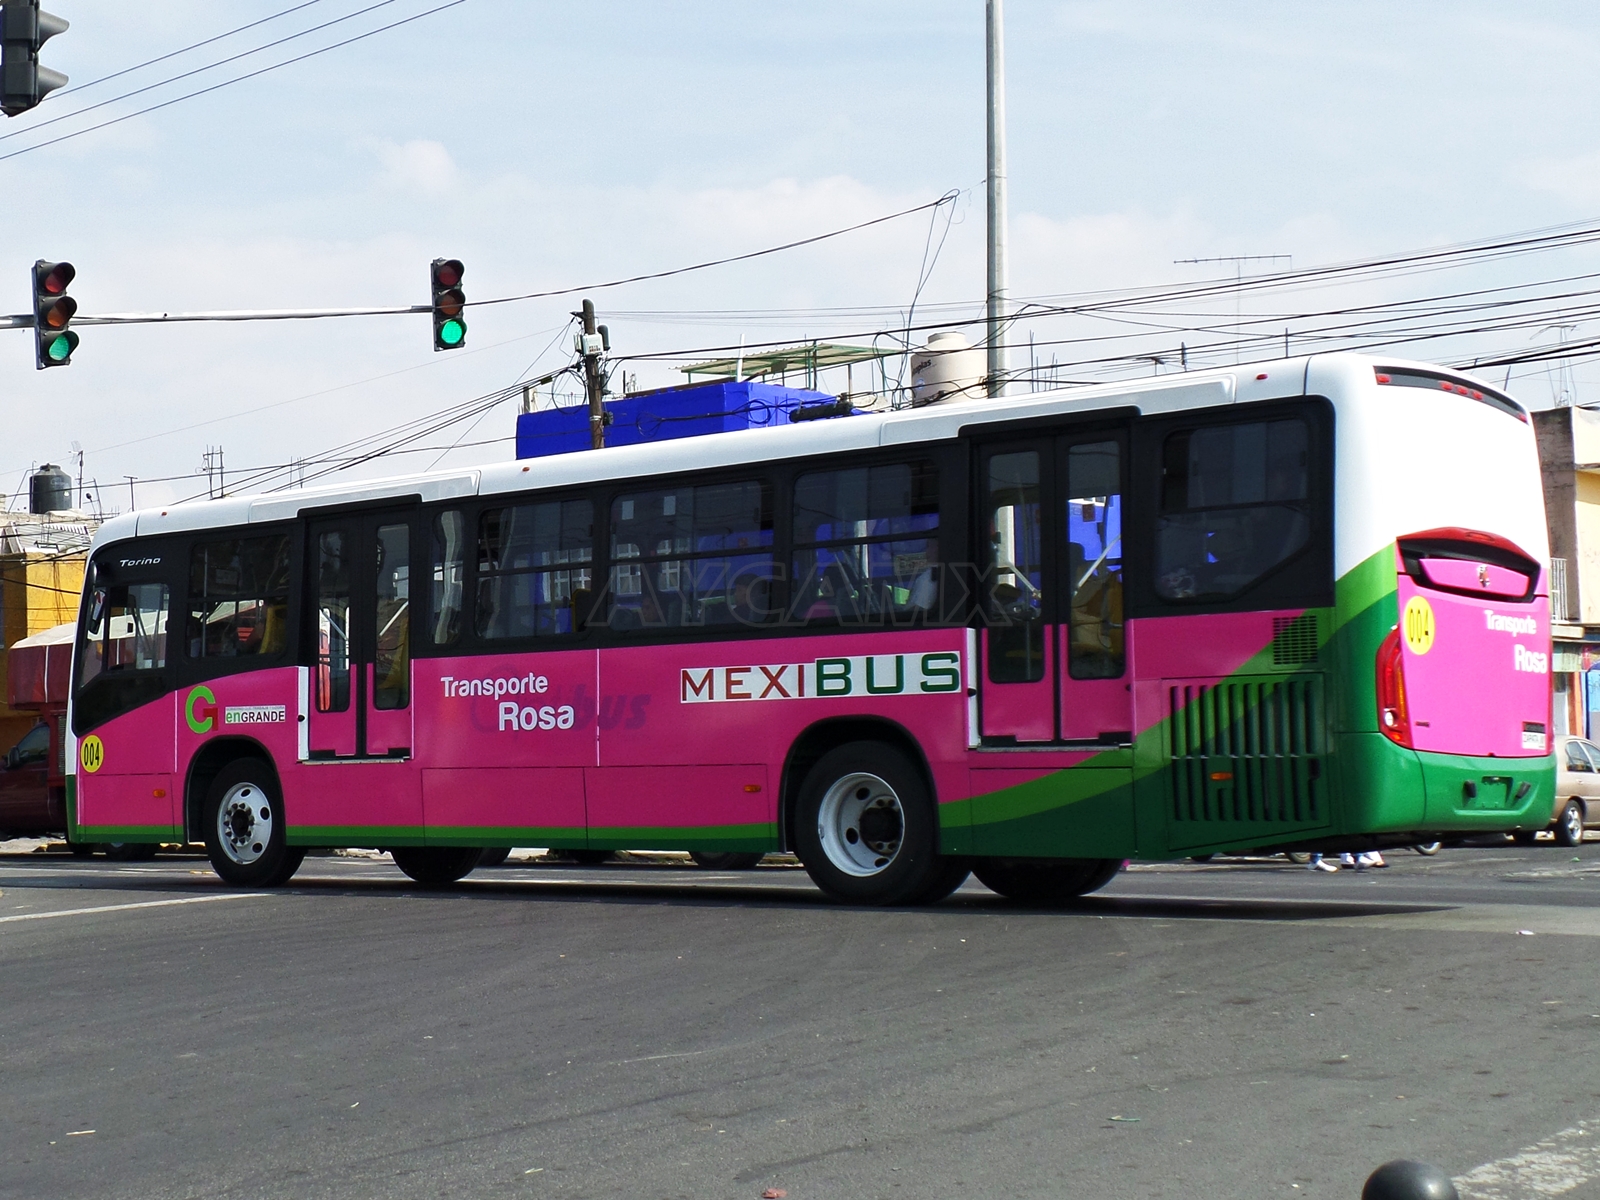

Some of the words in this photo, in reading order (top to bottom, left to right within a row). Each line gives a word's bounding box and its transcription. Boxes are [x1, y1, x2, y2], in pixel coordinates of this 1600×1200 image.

[119, 557, 161, 568] Torino
[1408, 608, 1430, 645] 004
[1484, 609, 1537, 638] Transporte
[1513, 643, 1547, 674] Rosa
[440, 672, 548, 700] Transporte
[681, 652, 961, 702] MEXIBUS
[498, 701, 576, 731] Rosa
[83, 741, 100, 767] 004
